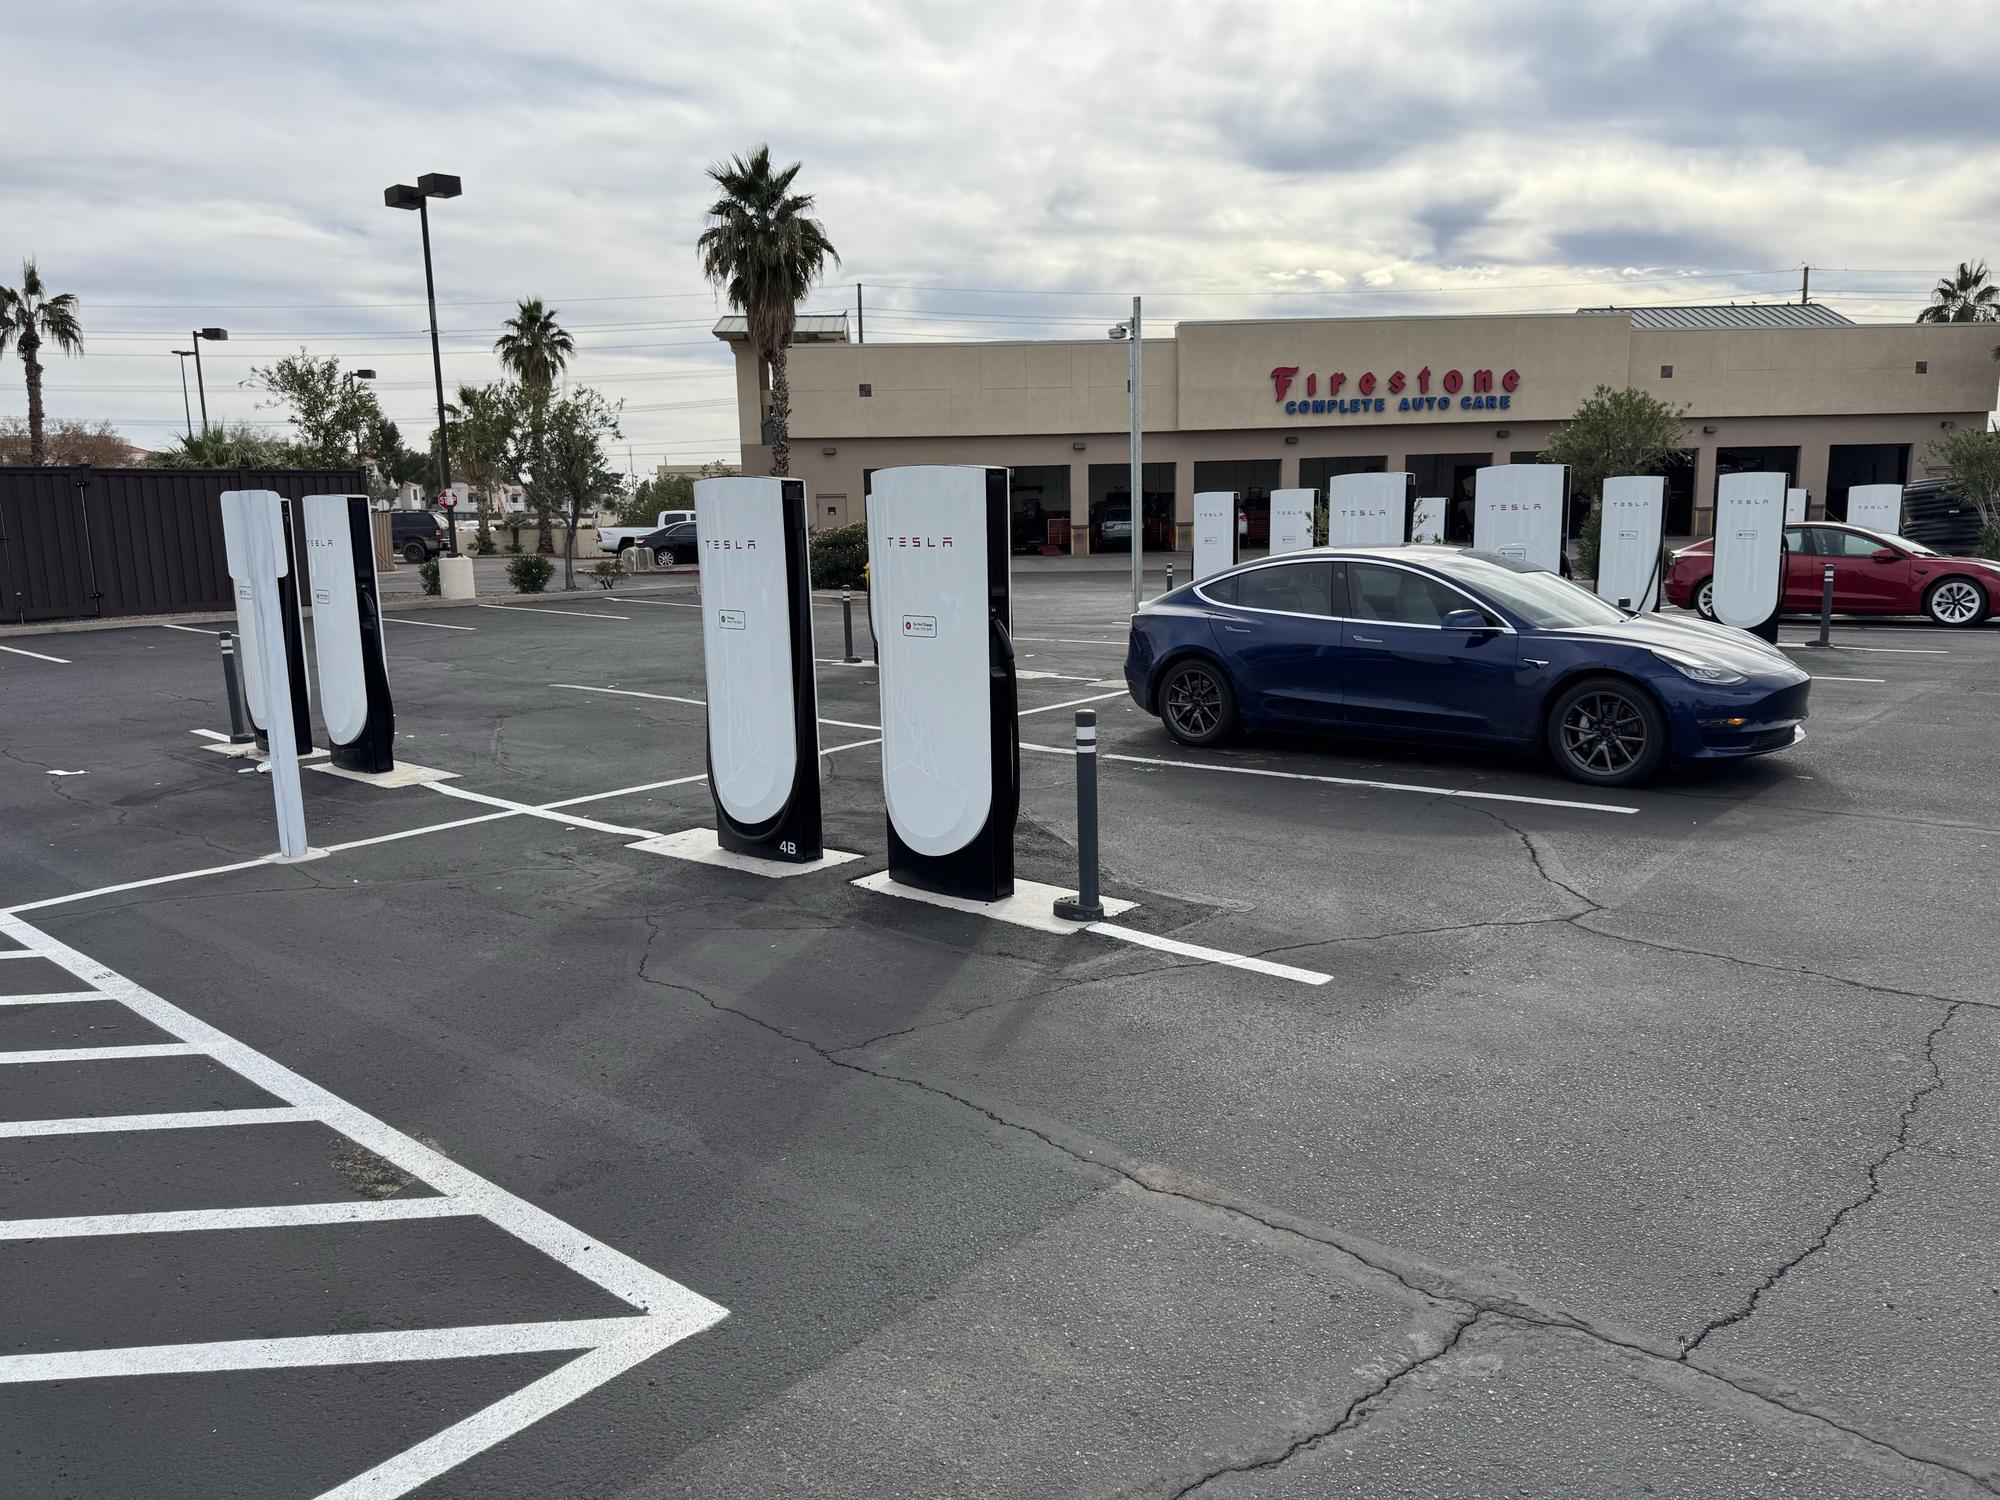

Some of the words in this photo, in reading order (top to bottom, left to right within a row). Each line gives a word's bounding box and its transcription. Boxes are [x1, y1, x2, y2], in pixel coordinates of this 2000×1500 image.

[1271, 366, 1521, 402] Firestone
[1285, 398, 1386, 415] COMPLETE
[1398, 396, 1451, 411] AUTO
[1460, 395, 1512, 410] CARE
[1489, 503, 1542, 511] TESLA
[1341, 509, 1386, 517] TESLA
[705, 540, 756, 550] TESLA
[887, 537, 953, 548] TESLA
[779, 840, 797, 855] 4B
